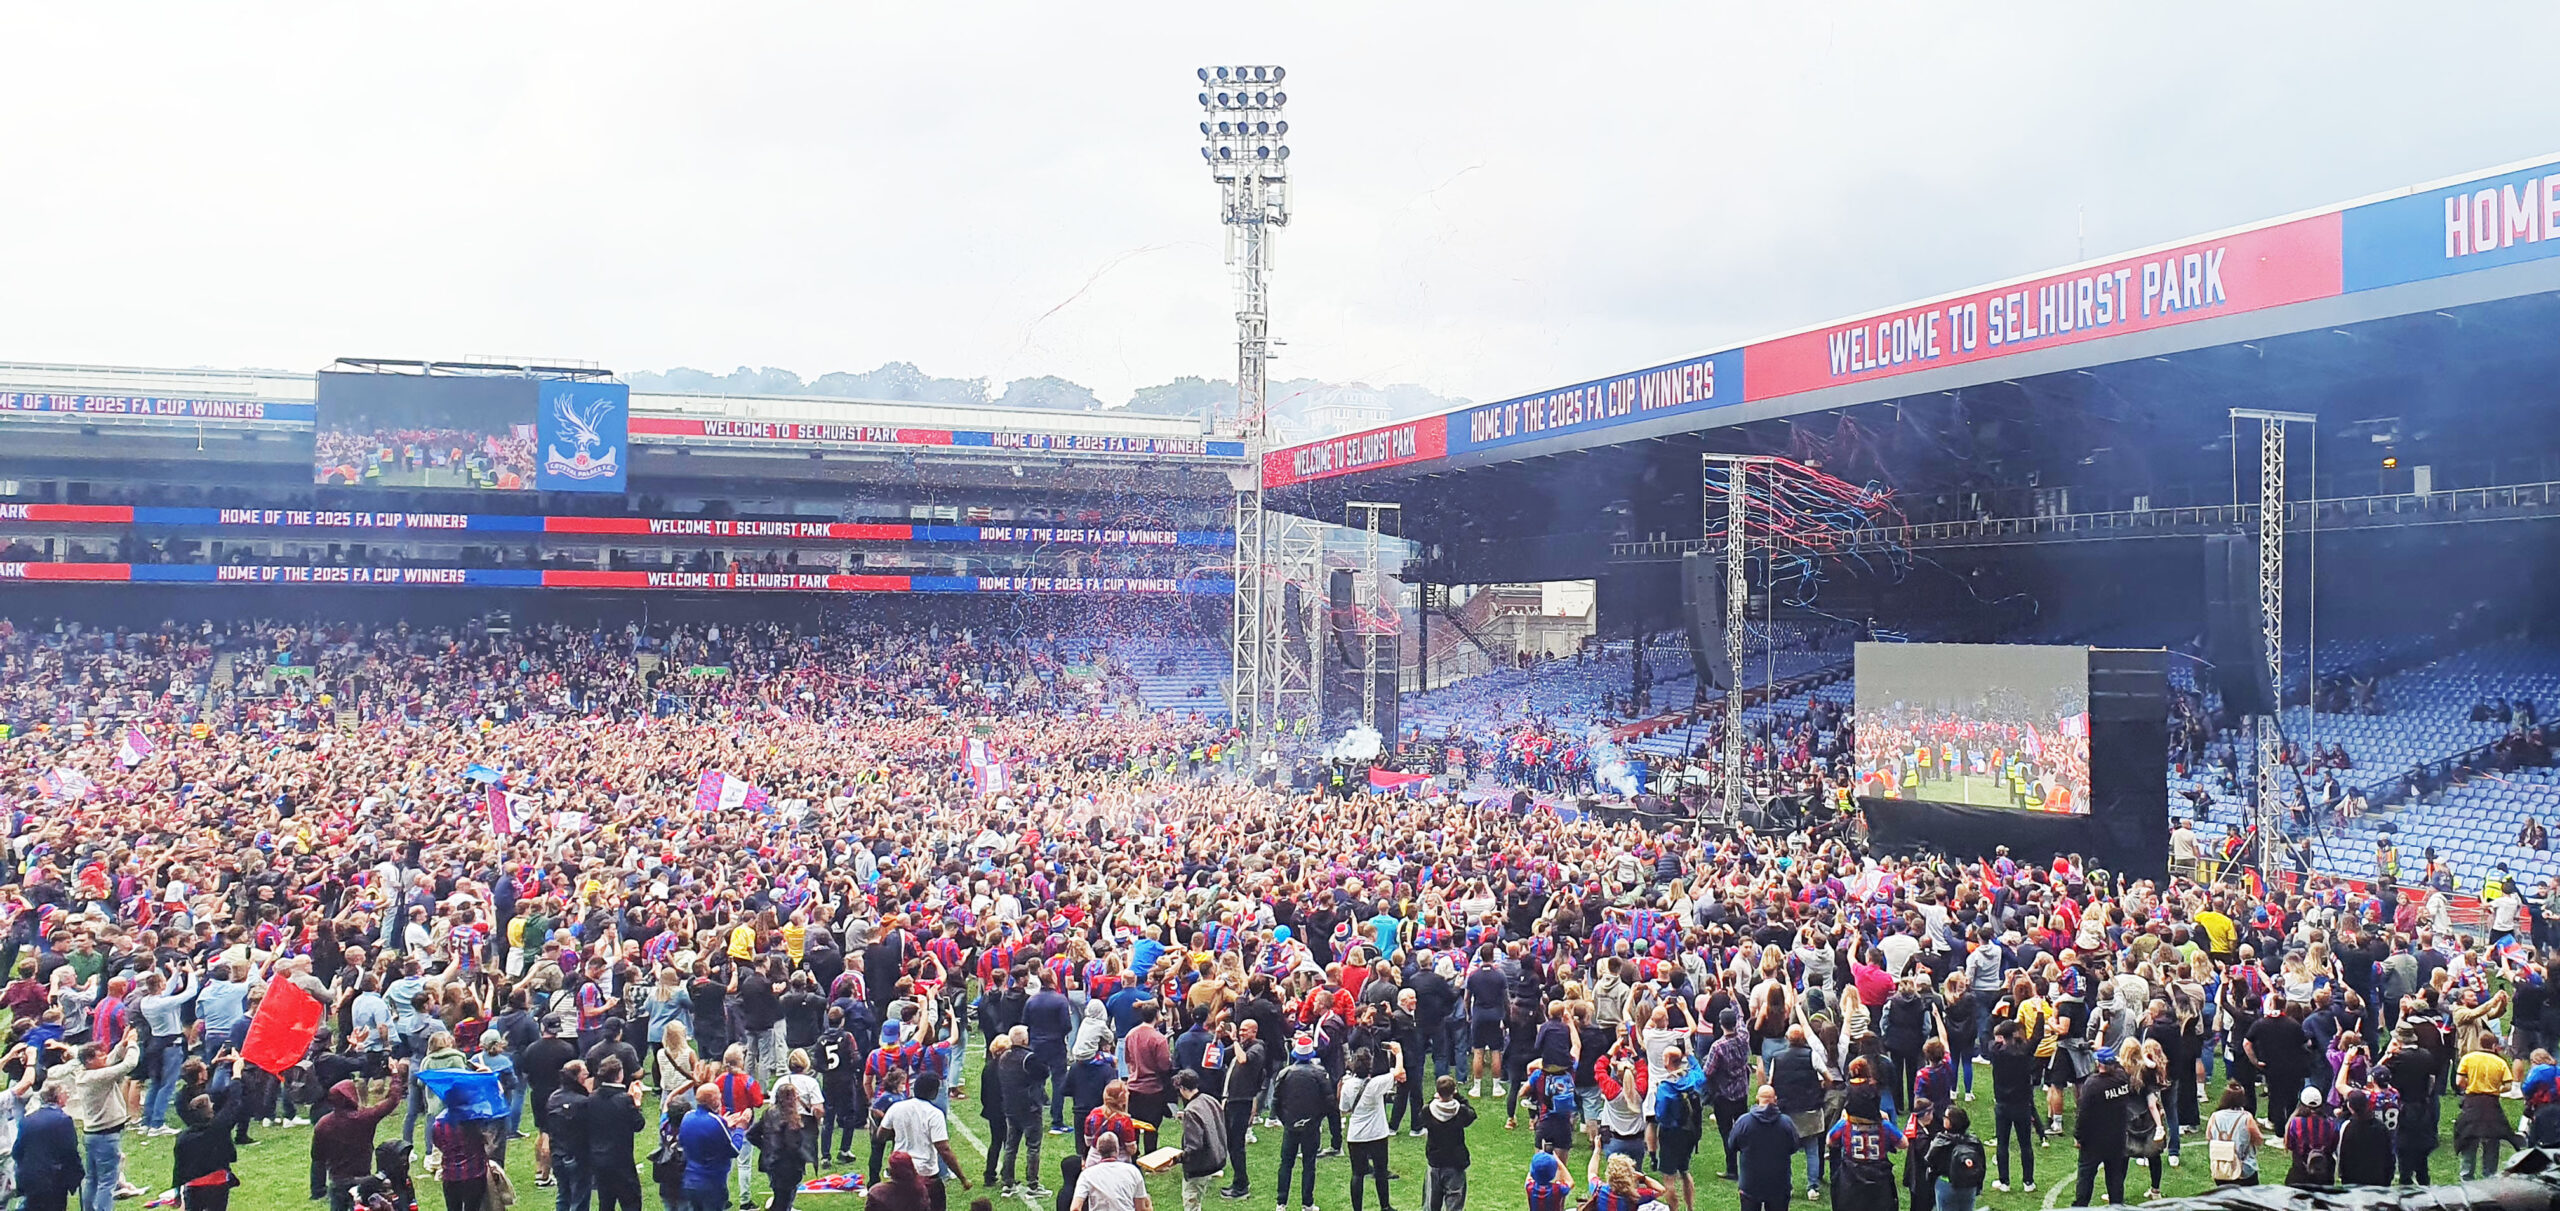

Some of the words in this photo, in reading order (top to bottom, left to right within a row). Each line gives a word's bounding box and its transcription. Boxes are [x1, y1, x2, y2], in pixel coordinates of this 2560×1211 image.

[2445, 172, 2560, 259] HOME
[1828, 311, 1940, 376] WELCOME
[1949, 303, 1977, 353] TO
[1988, 268, 2131, 347] SELHURST
[2142, 247, 2226, 316] PARK
[23, 393, 45, 410] OF
[49, 395, 79, 411] THE
[84, 397, 126, 414] 2025
[131, 398, 152, 414] FA
[156, 400, 187, 416] CUP
[192, 401, 265, 418] WINNERS
[1471, 406, 1501, 443] HOME
[1504, 401, 1520, 437] OF
[1523, 397, 1546, 433] THE
[1549, 389, 1583, 429] 2025
[1586, 384, 1605, 421] FA
[1608, 377, 1636, 417] CUP
[1640, 360, 1715, 411] WINNERS
[704, 420, 770, 437] WELCOME
[775, 423, 790, 438] TO
[798, 424, 864, 442] SELHURST
[867, 427, 900, 442] PARK
[993, 432, 1027, 448] HOME
[1030, 434, 1047, 448] OF
[1050, 435, 1073, 450] THE
[1076, 435, 1106, 451] 2025
[1110, 437, 1125, 451] FA
[1128, 438, 1151, 452] CUP
[1155, 438, 1208, 454] WINNERS
[1294, 443, 1332, 477] WELCOME
[1335, 440, 1345, 469] TO
[1347, 432, 1391, 467] SELHURST
[1393, 426, 1417, 457] PARK
[0, 504, 29, 519] ARK
[220, 509, 258, 524] HOME
[263, 511, 282, 525] OF
[286, 511, 311, 525] THE
[315, 512, 351, 526] 2025
[355, 513, 373, 527] FA
[375, 514, 402, 527] CUP
[406, 514, 468, 529] WINNERS
[650, 519, 711, 534] WELCOME
[715, 521, 729, 534] TO
[737, 522, 797, 536] SELHURST
[801, 523, 831, 537] PARK
[980, 527, 1012, 541] HOME
[1032, 529, 1052, 542] THE
[1056, 529, 1084, 542] 2025
[1087, 530, 1101, 543] FA
[1104, 530, 1125, 543] CUP
[1128, 530, 1178, 545] WINNERS
[217, 566, 257, 581] HOME
[261, 567, 280, 581] OF
[284, 567, 309, 582] THE
[313, 568, 349, 582] 2025
[352, 569, 370, 583] FA
[373, 570, 400, 583] CUP
[403, 569, 466, 584] WINNERS
[648, 573, 709, 587] WELCOME
[713, 574, 728, 587] TO
[735, 574, 796, 588] SELHURST
[800, 575, 830, 589] PARK
[979, 577, 1011, 591] HOME
[1013, 578, 1028, 591] OF
[1031, 577, 1051, 591] THE
[1055, 577, 1083, 592] 2025
[1086, 579, 1100, 592] FA
[1103, 578, 1124, 592] CUP
[1127, 578, 1177, 593] WINNERS
[825, 1044, 840, 1070] 5
[2105, 1084, 2129, 1100] PALACE
[1851, 1135, 1880, 1160] 25
